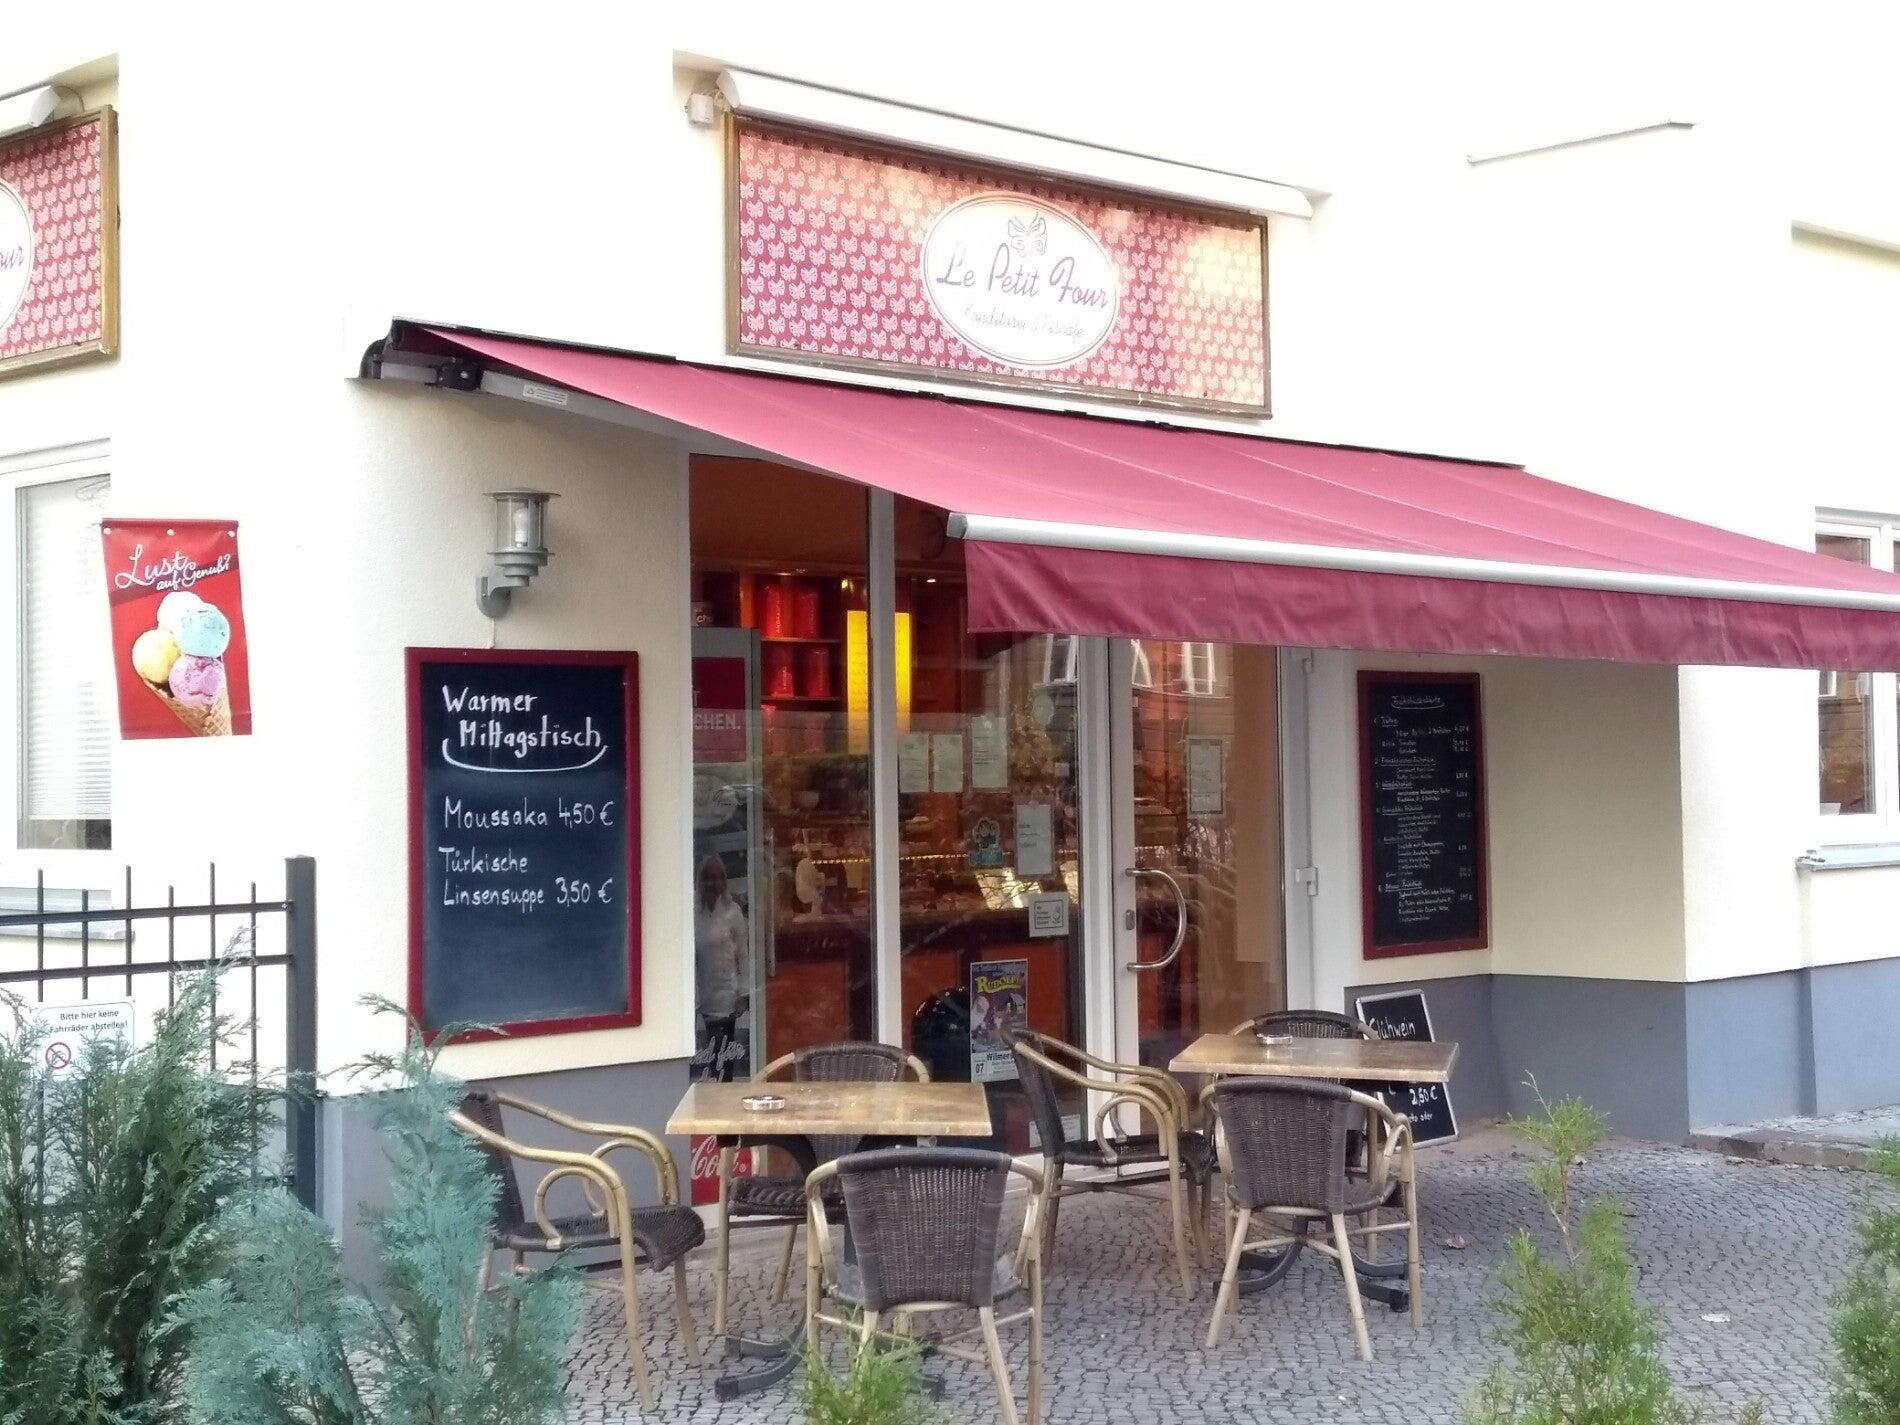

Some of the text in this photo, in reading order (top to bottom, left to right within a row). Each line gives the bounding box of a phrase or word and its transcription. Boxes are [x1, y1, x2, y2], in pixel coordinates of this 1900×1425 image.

[936, 239, 1109, 309] Le Petit Four
[115, 543, 189, 588] Lust
[156, 553, 231, 590] auf Genuß?
[441, 684, 538, 714] Warmer
[459, 714, 601, 758] Mittagstisch
[444, 795, 614, 829] Moussaka 4,50 €
[438, 846, 528, 873] Türkische
[443, 878, 545, 913] Linsensuppe
[597, 877, 613, 904] €
[49, 1024, 89, 1033] Fahrräder
[60, 1010, 119, 1022] Bitte hier keine
[976, 1062, 984, 1073] 07
